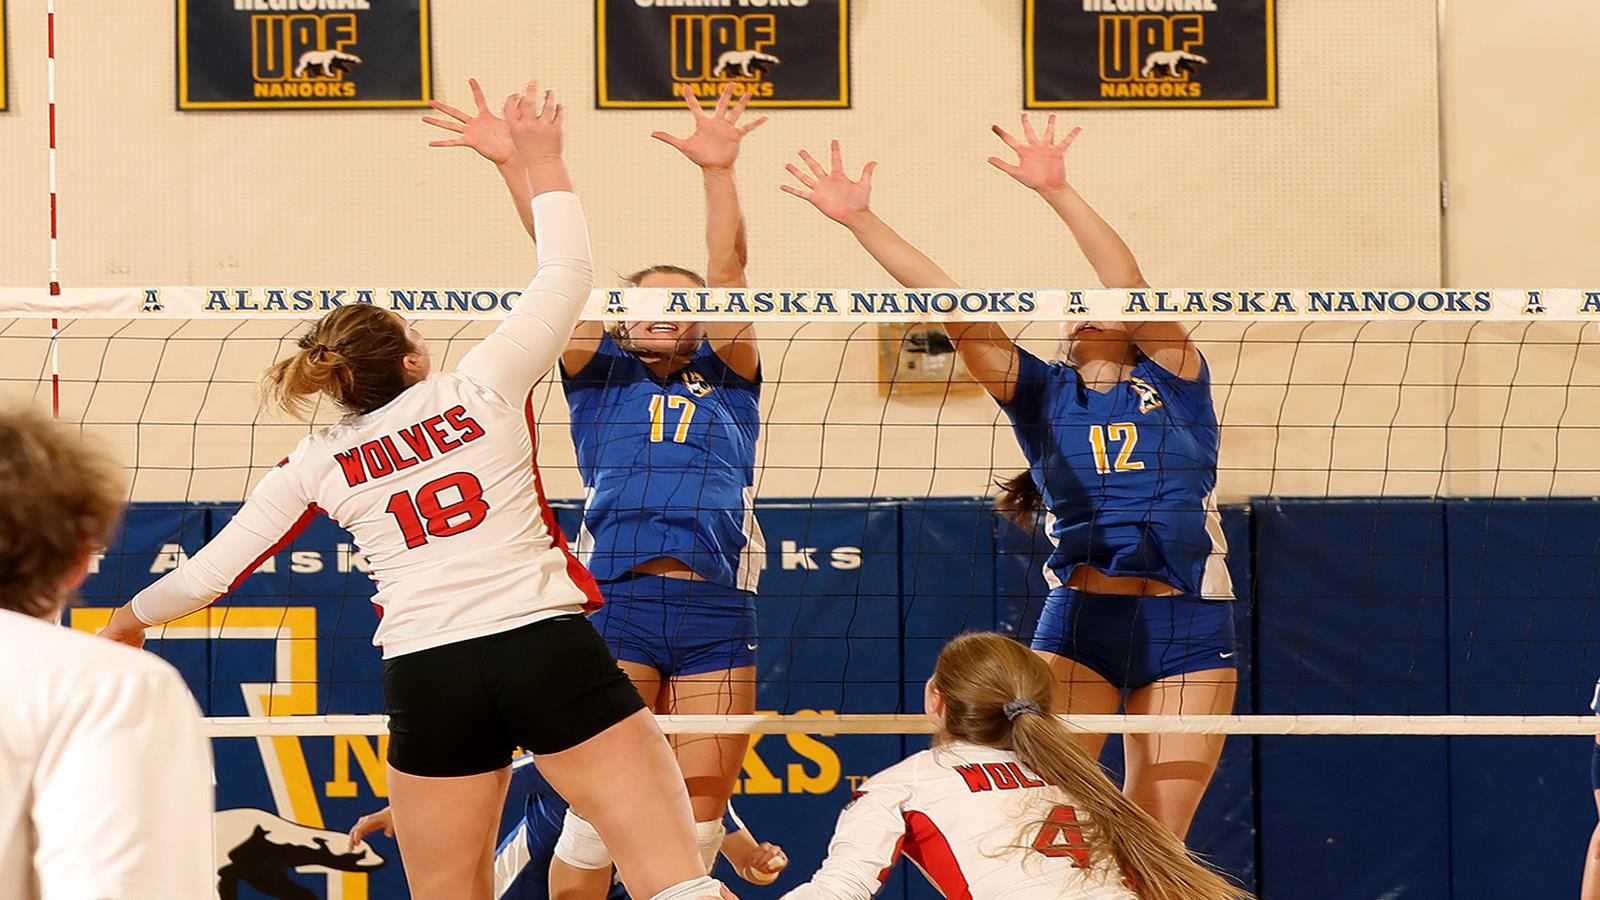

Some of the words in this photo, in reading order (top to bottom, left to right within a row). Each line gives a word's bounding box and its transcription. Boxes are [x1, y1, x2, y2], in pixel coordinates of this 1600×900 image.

[253, 82, 356, 97] NANOOKS
[1100, 82, 1202, 97] NANOOKS
[204, 290, 374, 311] ALASKA
[666, 291, 838, 313] ALASKA
[850, 291, 1036, 314] NANOOKS
[1125, 291, 1296, 312] ALASKA
[1308, 291, 1494, 312] NANOOKS
[648, 394, 696, 443] 17
[334, 404, 486, 487] WOLVES
[1089, 421, 1145, 475] 12
[385, 471, 491, 549] 18
